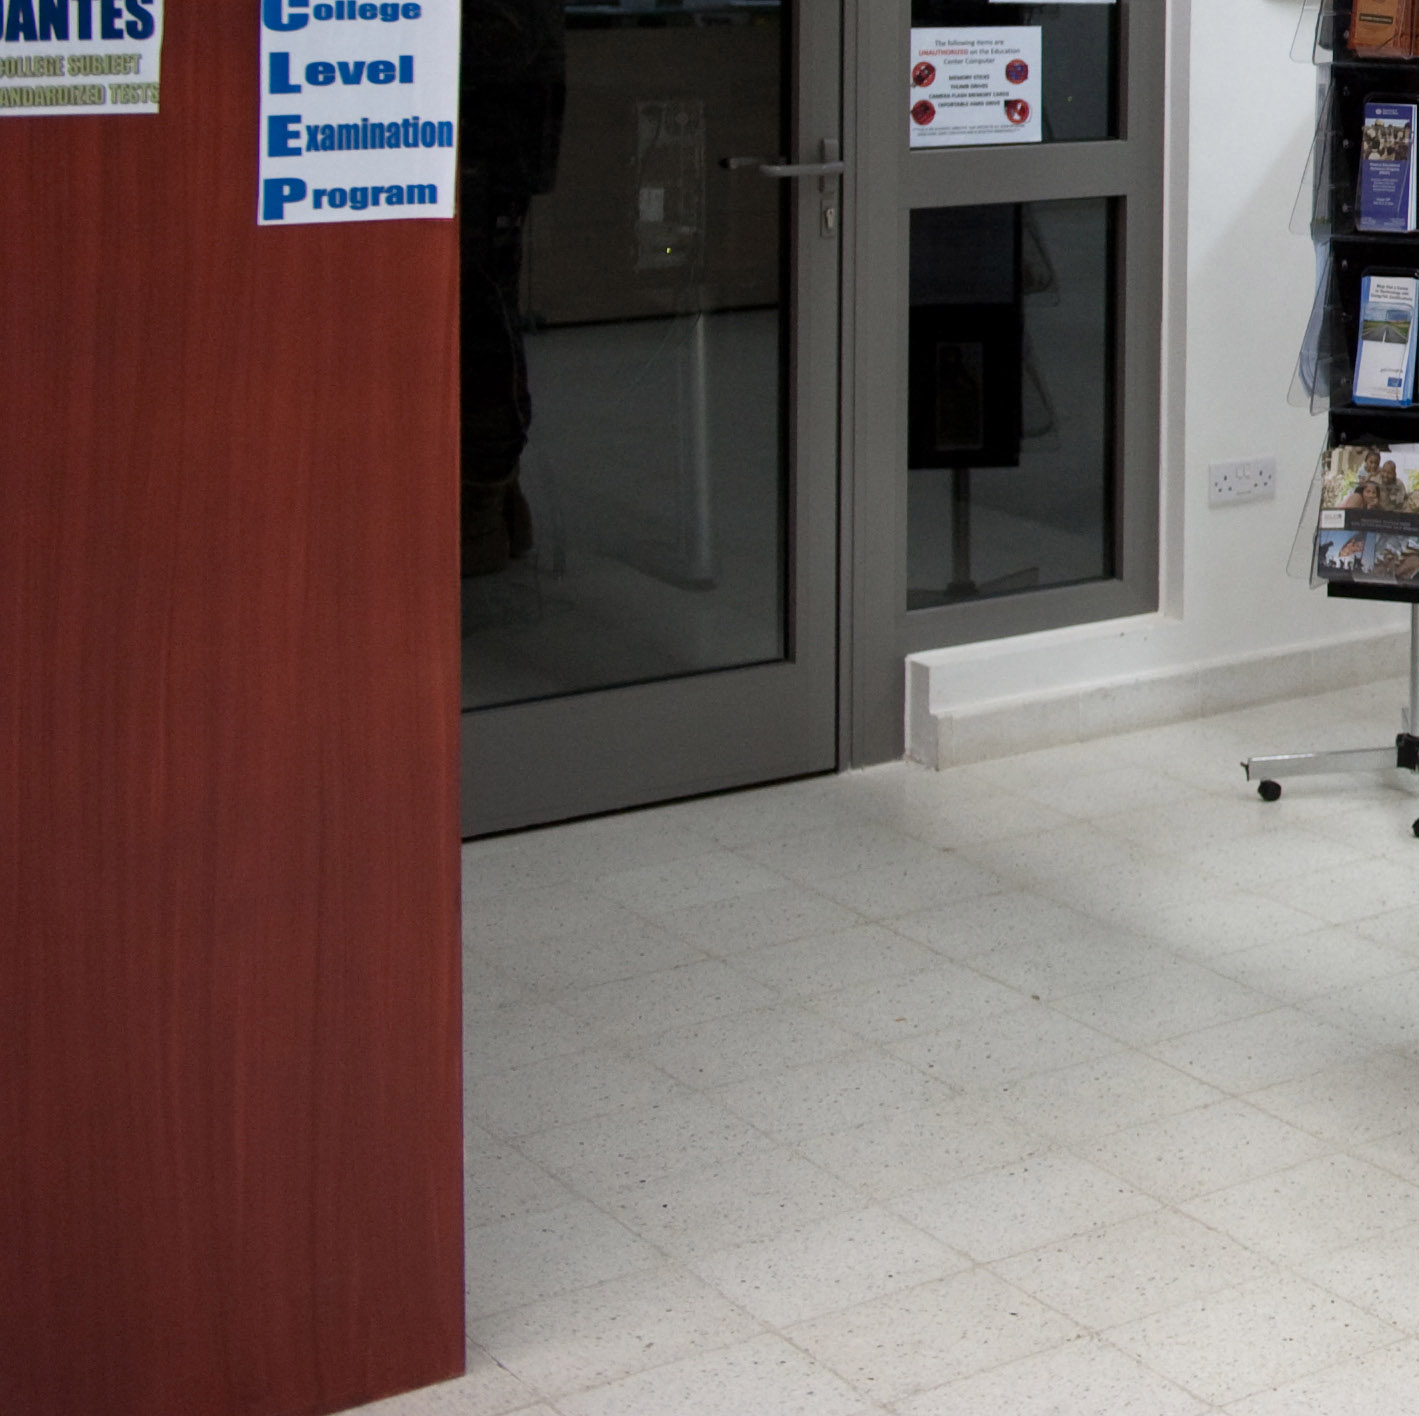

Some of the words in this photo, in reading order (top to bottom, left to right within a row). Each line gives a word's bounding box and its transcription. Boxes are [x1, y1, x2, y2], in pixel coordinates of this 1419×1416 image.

[67, 54, 143, 77] SUBJECT
[269, 52, 413, 95] Level
[0, 84, 106, 107] ANDARDIZED
[109, 82, 159, 105] TESTS
[267, 114, 454, 157] Examination
[263, 178, 438, 221] Program
